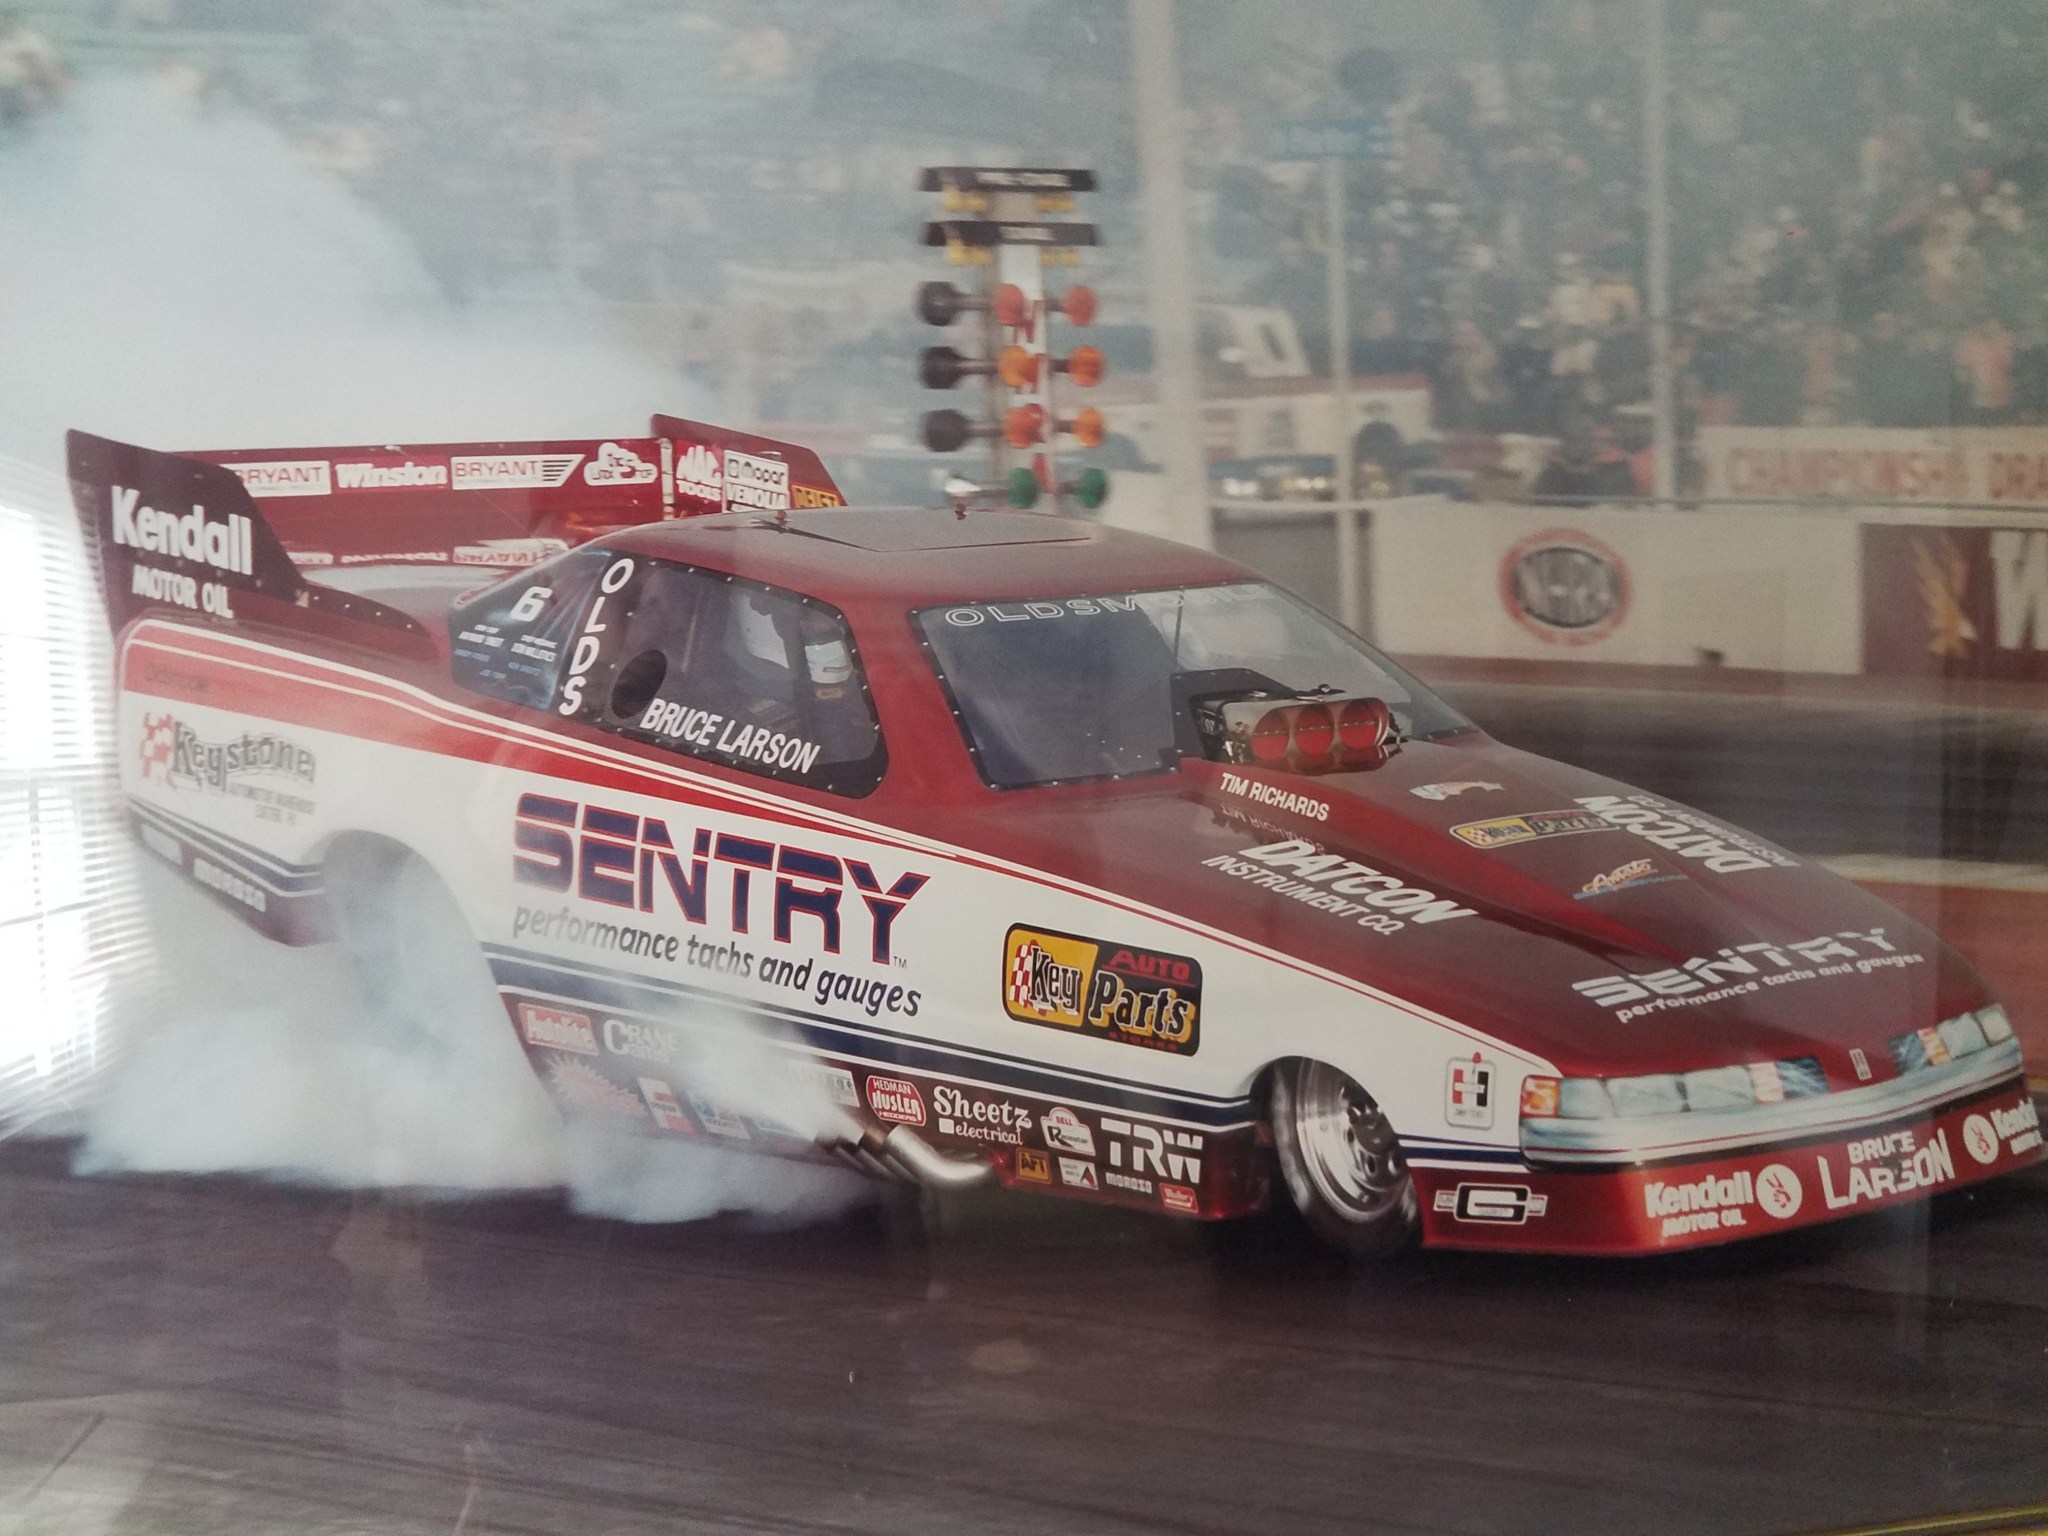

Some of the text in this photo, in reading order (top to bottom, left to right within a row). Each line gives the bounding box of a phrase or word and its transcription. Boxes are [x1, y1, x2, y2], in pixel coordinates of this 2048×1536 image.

[335, 461, 448, 489] Winston
[454, 460, 539, 478] BRYANT
[111, 484, 253, 576] Kendall
[132, 565, 234, 618] MOTOR OIL
[510, 586, 552, 622] 6
[559, 558, 635, 716] OLDS
[640, 698, 821, 774] BRUCE LARSON
[1220, 772, 1330, 821] TIM RICHARDS
[512, 792, 932, 966] SENTRY
[1201, 855, 1405, 936] INSTRUMENT CO.
[1237, 839, 1480, 924] DATCON
[513, 904, 922, 1018] performance tachs and gauges
[1029, 946, 1081, 1015] Key
[1107, 949, 1191, 982] AUTO
[1571, 927, 1898, 1008] SENTRY
[1615, 951, 1925, 1024] performance tachs and gauges
[1088, 969, 1193, 1039] Parts
[872, 1078, 912, 1095] HEDMAN
[932, 1084, 1032, 1130] Sheetz
[955, 1122, 1024, 1146] electrical
[1100, 1117, 1204, 1185] TRW
[1847, 1131, 1917, 1165] BRUCE
[1644, 1170, 1755, 1219] Kendall
[1817, 1127, 1956, 1210] LARSON
[1661, 1209, 1748, 1238] MOTOR OIL
